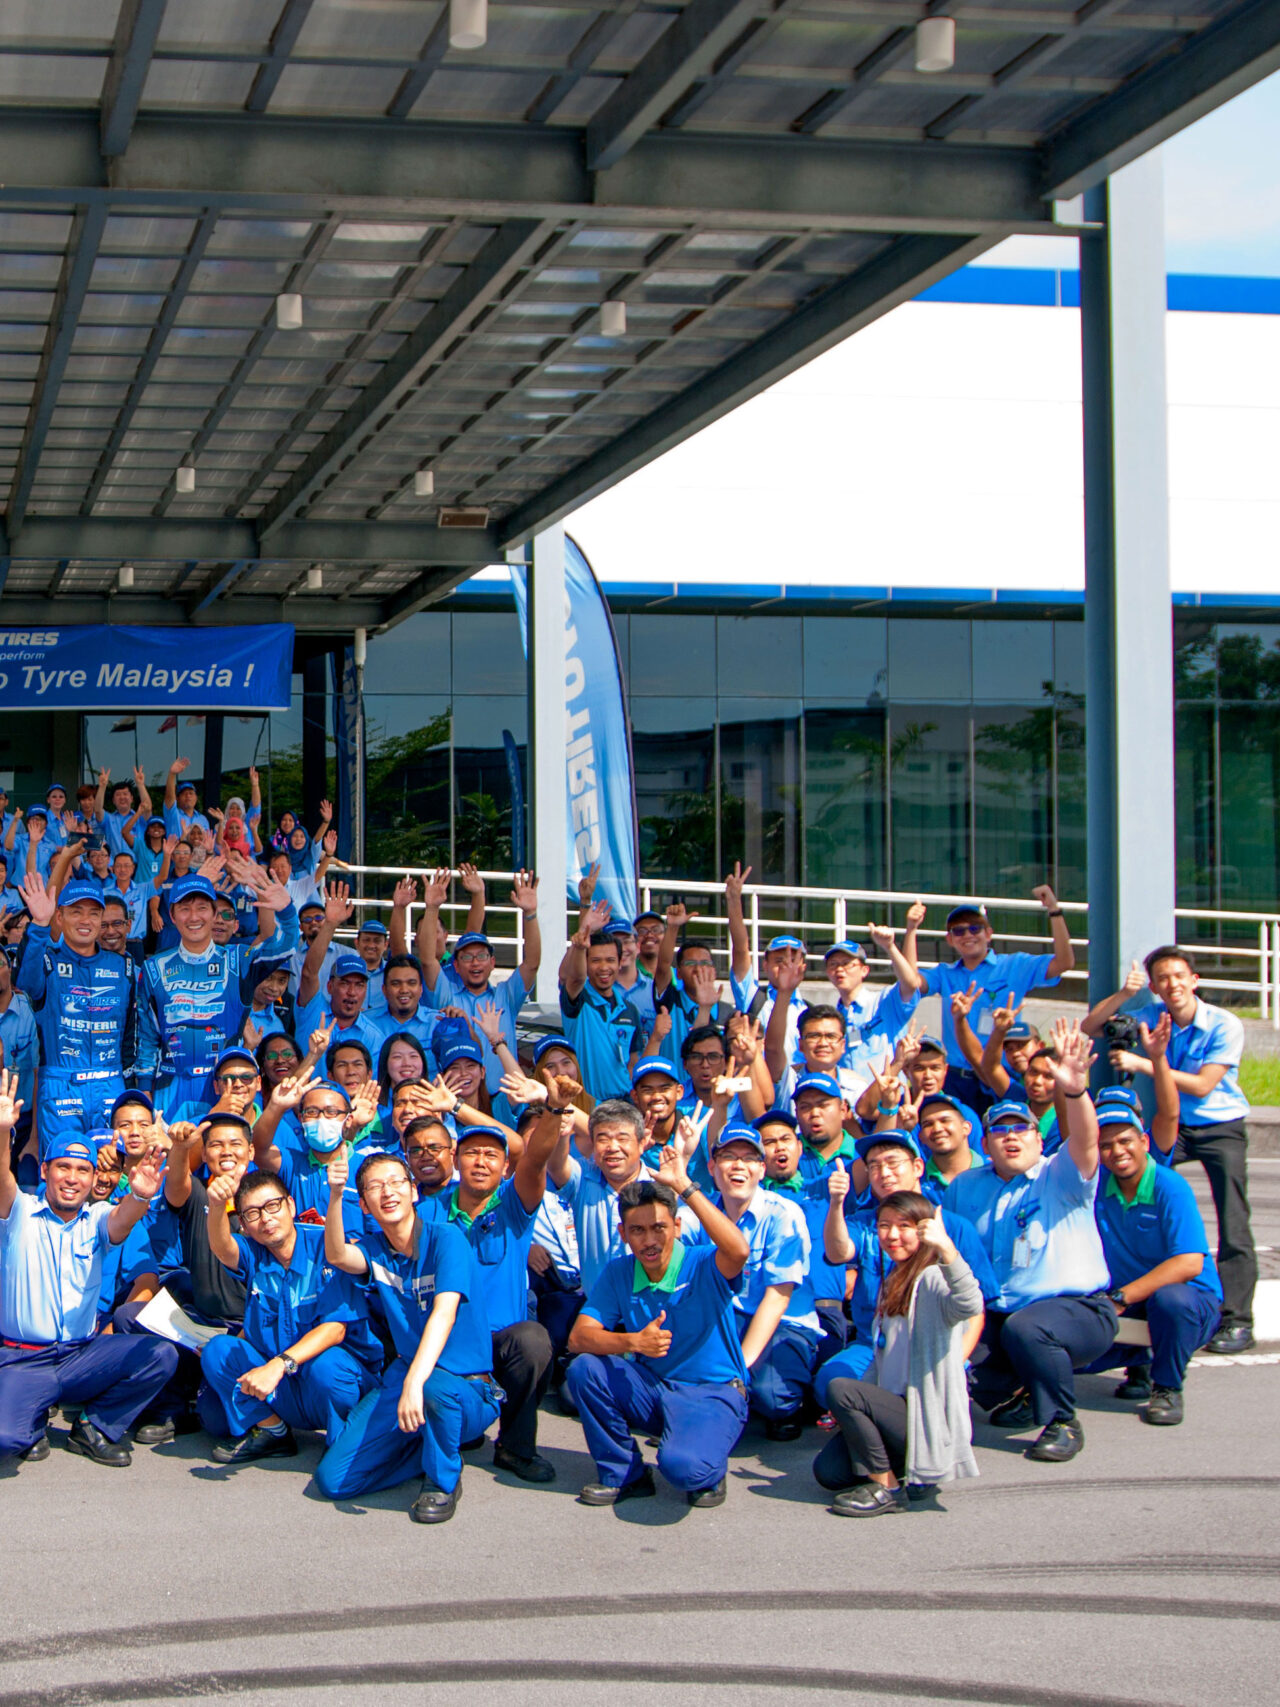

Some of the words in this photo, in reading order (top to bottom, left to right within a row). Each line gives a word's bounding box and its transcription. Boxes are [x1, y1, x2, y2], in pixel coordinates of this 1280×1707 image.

[22, 665, 87, 695] Tyre
[96, 663, 234, 694] Malaysia
[243, 663, 255, 688] !
[164, 980, 225, 992] TRUST
